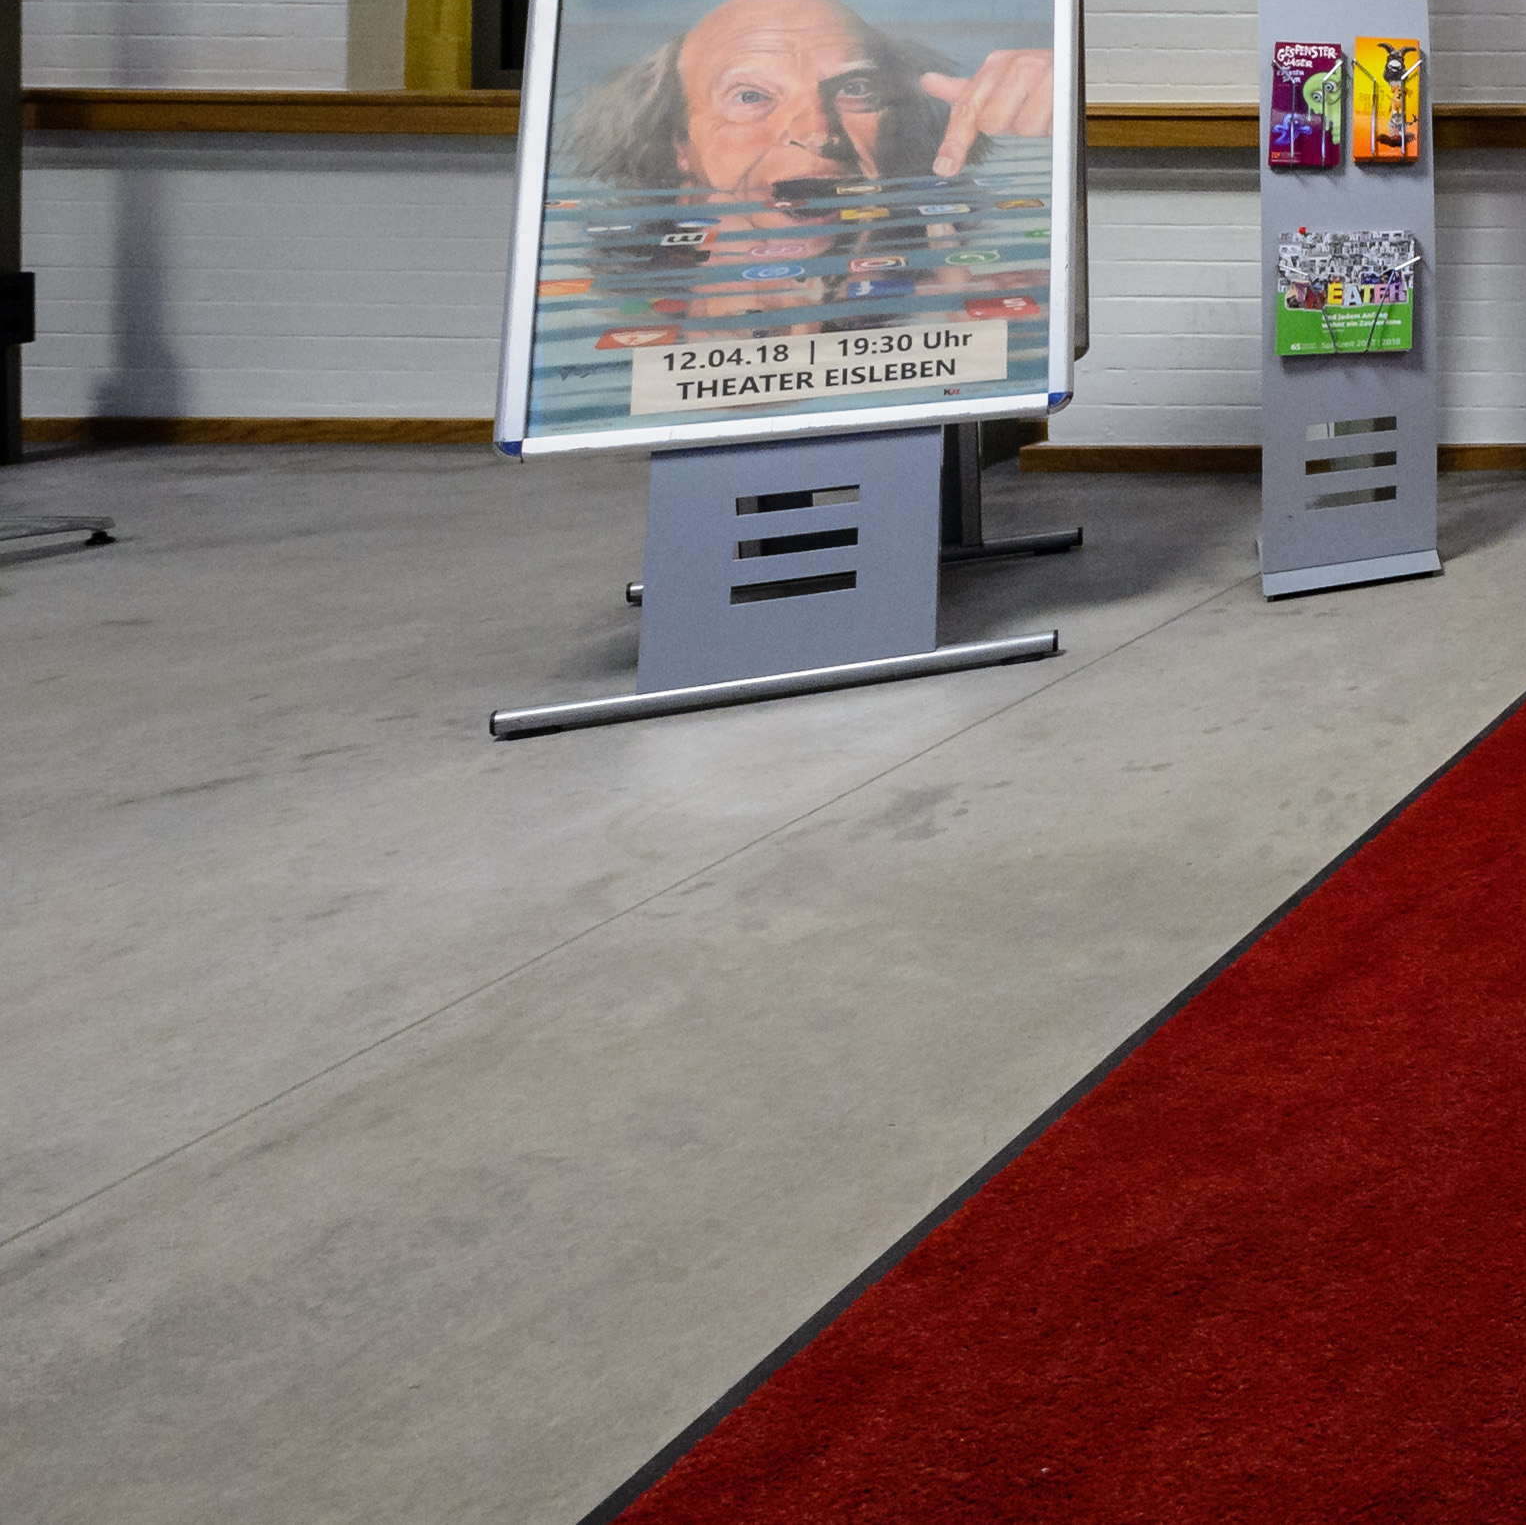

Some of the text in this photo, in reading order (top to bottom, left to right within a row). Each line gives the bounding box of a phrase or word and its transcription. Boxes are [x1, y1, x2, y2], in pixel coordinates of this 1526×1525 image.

[1277, 44, 1338, 62] GESPENSTER-
[663, 344, 789, 371] 12.04.18
[837, 333, 913, 357] 19:30
[923, 330, 973, 350] Uhr
[676, 358, 956, 400] THEATER EISLEBEN
